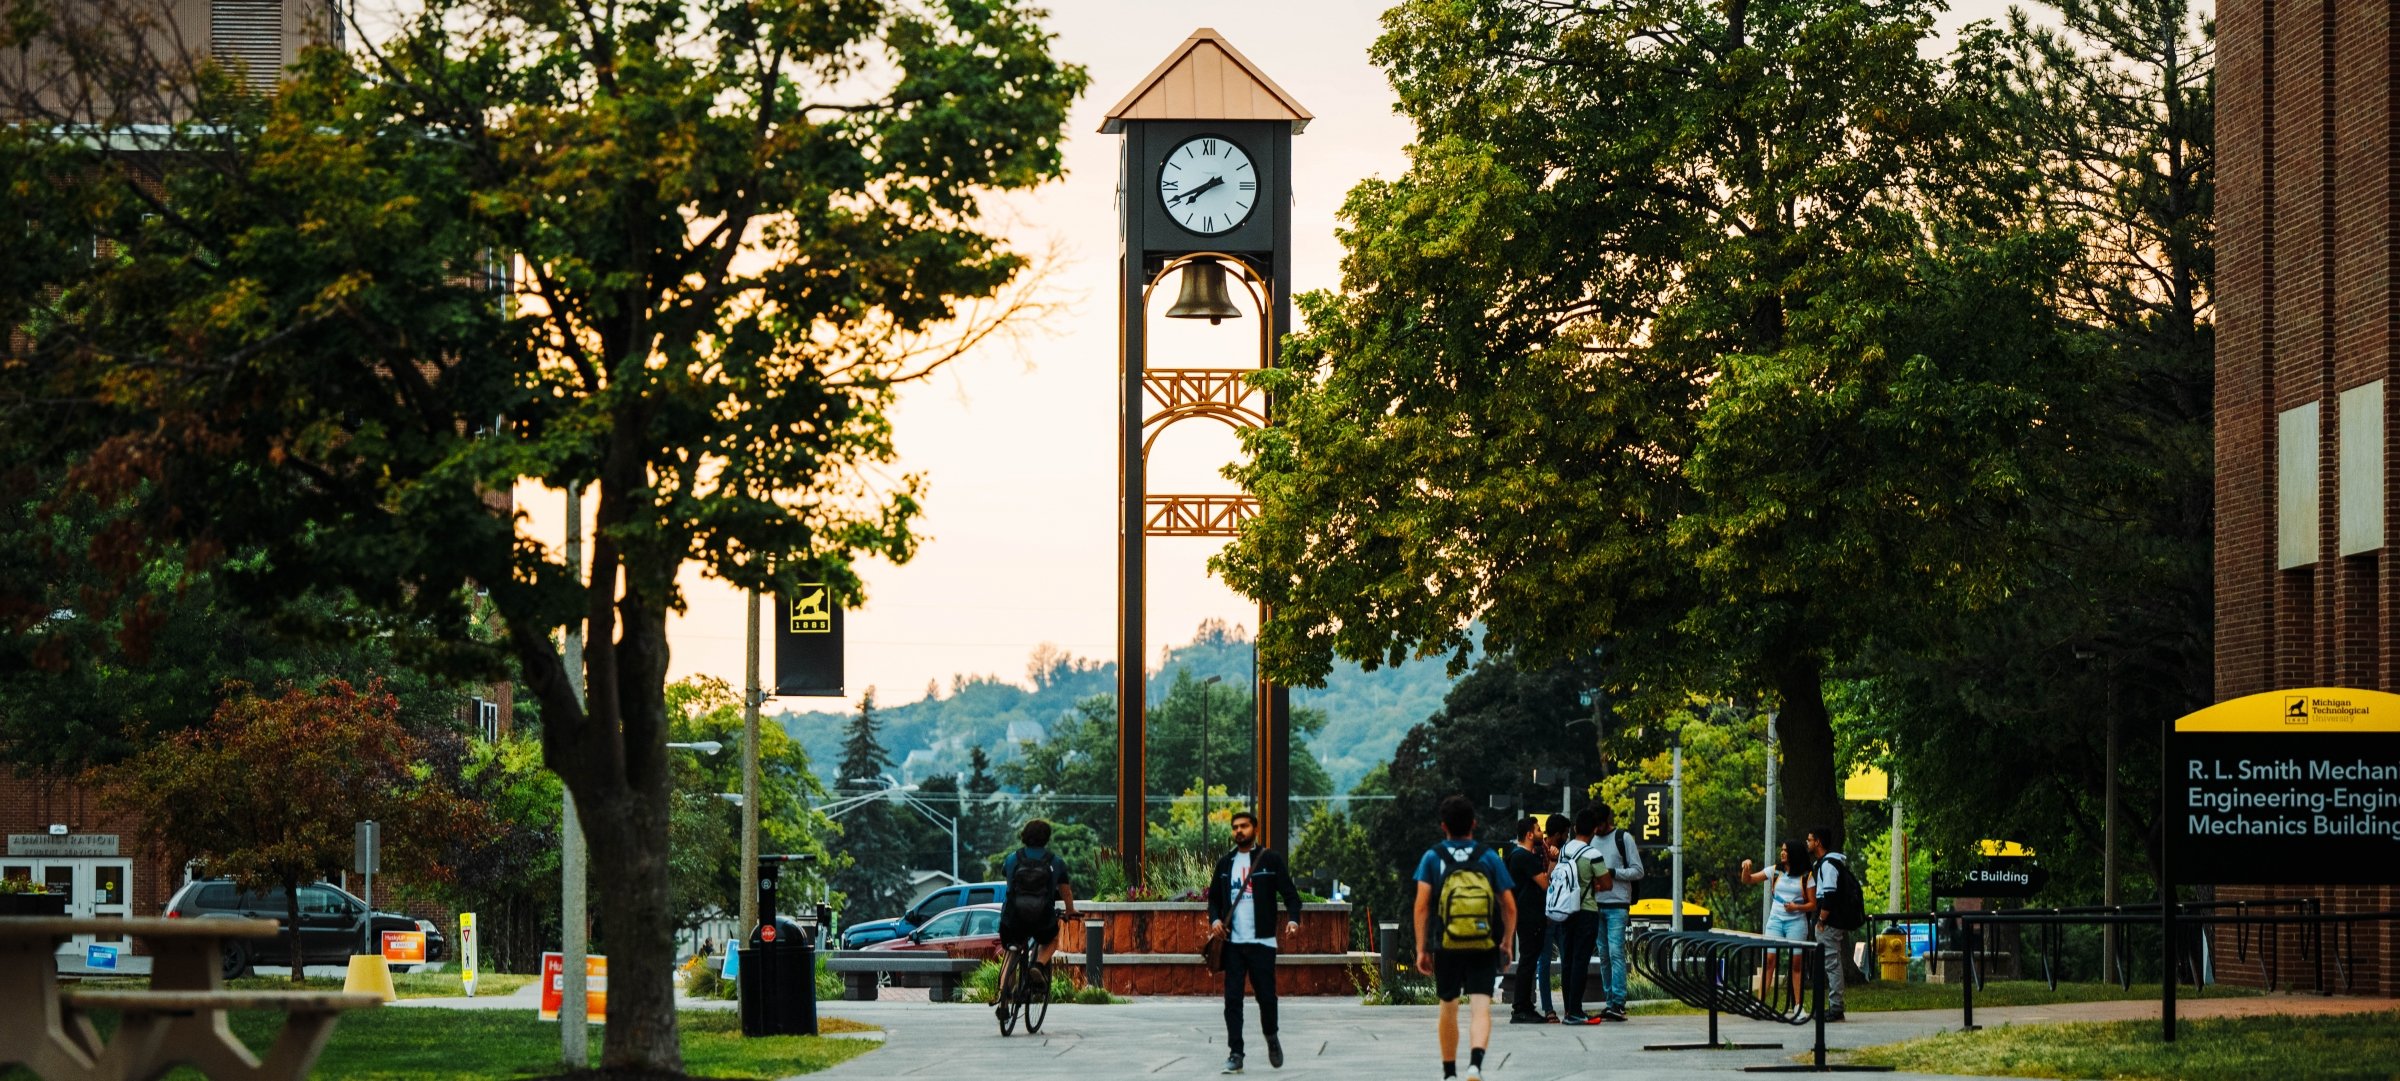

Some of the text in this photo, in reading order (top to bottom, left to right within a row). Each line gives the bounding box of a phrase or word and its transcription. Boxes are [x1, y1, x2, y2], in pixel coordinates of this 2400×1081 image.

[1202, 139, 1216, 156] XII
[2312, 700, 2351, 708] Michigan
[2312, 707, 2369, 715] Technological
[2188, 760, 2209, 780] R.
[2215, 760, 2233, 780] L.
[2238, 759, 2302, 780] Smith
[2188, 787, 2400, 813] Engineering-Engin
[1643, 792, 1660, 840] Tech
[2188, 814, 2400, 840] Mechanics Building
[13, 836, 115, 845] ADMINISTRATION
[1981, 870, 2029, 885] Building
